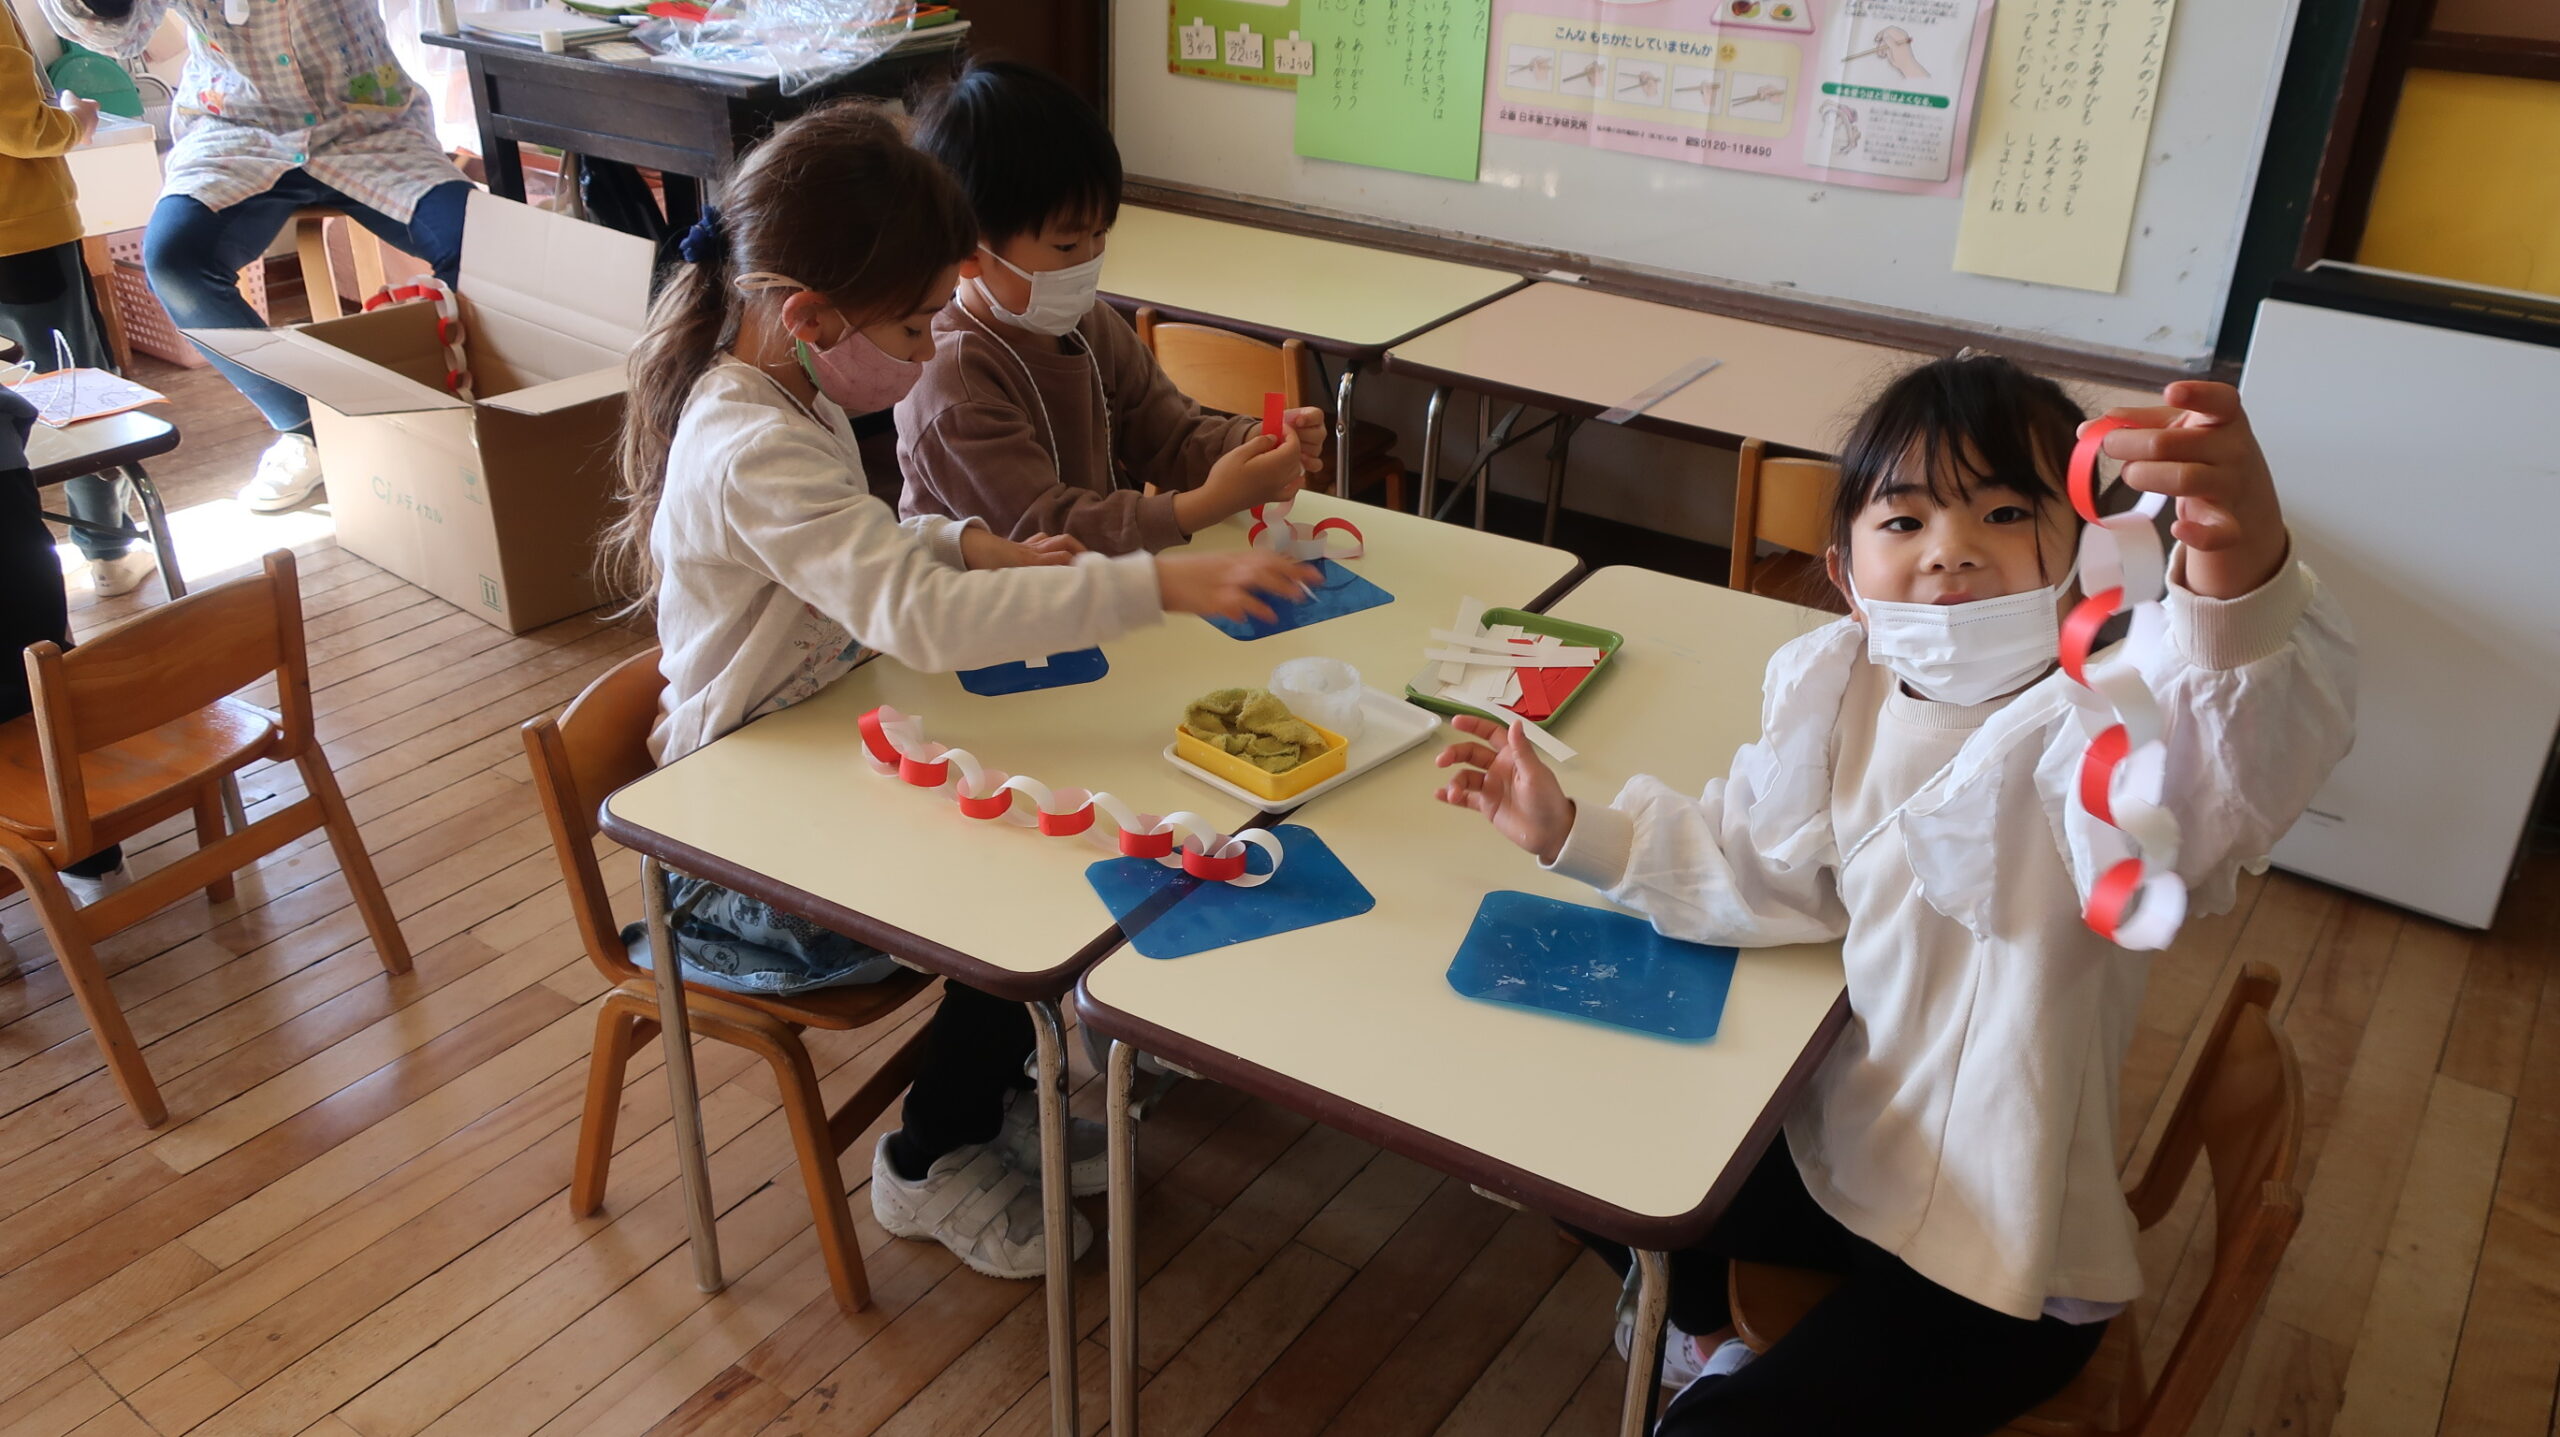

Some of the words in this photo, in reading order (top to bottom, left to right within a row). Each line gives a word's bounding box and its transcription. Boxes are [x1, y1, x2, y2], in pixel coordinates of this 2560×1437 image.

[1555, 26, 1586, 41] こんな
[1333, 36, 1346, 110] ありがとう
[1349, 38, 1365, 110] ありがとう
[1700, 138, 1772, 157] 0120-118490
[1991, 131, 2016, 211] しましたね
[2015, 132, 2036, 213] しましたね
[2038, 137, 2063, 213] えんそくも
